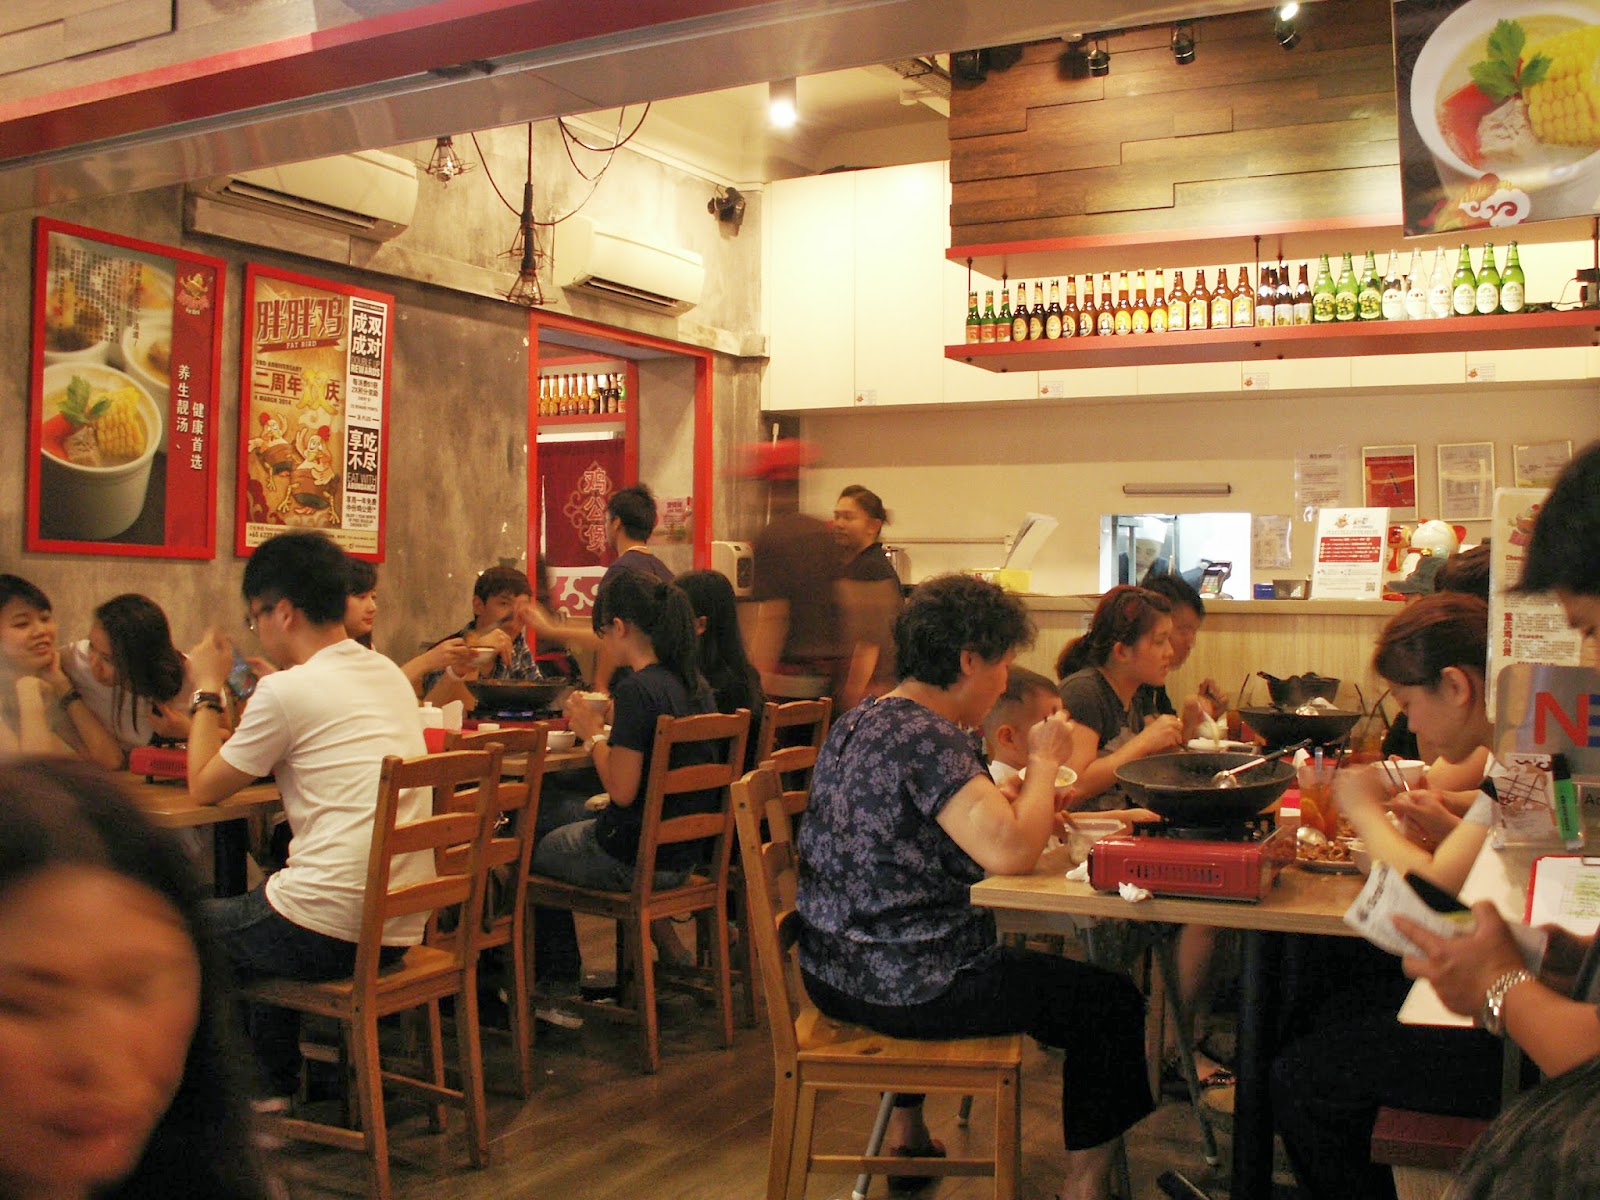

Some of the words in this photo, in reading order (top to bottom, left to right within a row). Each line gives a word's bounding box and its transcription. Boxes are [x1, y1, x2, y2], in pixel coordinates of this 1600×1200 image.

[256, 296, 344, 343] 胖胖鸡
[352, 312, 382, 336] 成双
[286, 342, 298, 350] FAT
[300, 340, 317, 348] BIRD
[351, 334, 382, 358] 成对
[350, 363, 381, 377] REWARDS
[259, 395, 278, 403] MARCH
[190, 402, 205, 470] 健康首选
[348, 429, 378, 453] 享吃
[348, 450, 377, 472] 不尽
[1379, 469, 1403, 496] A
[583, 467, 607, 552] 鸡公煲
